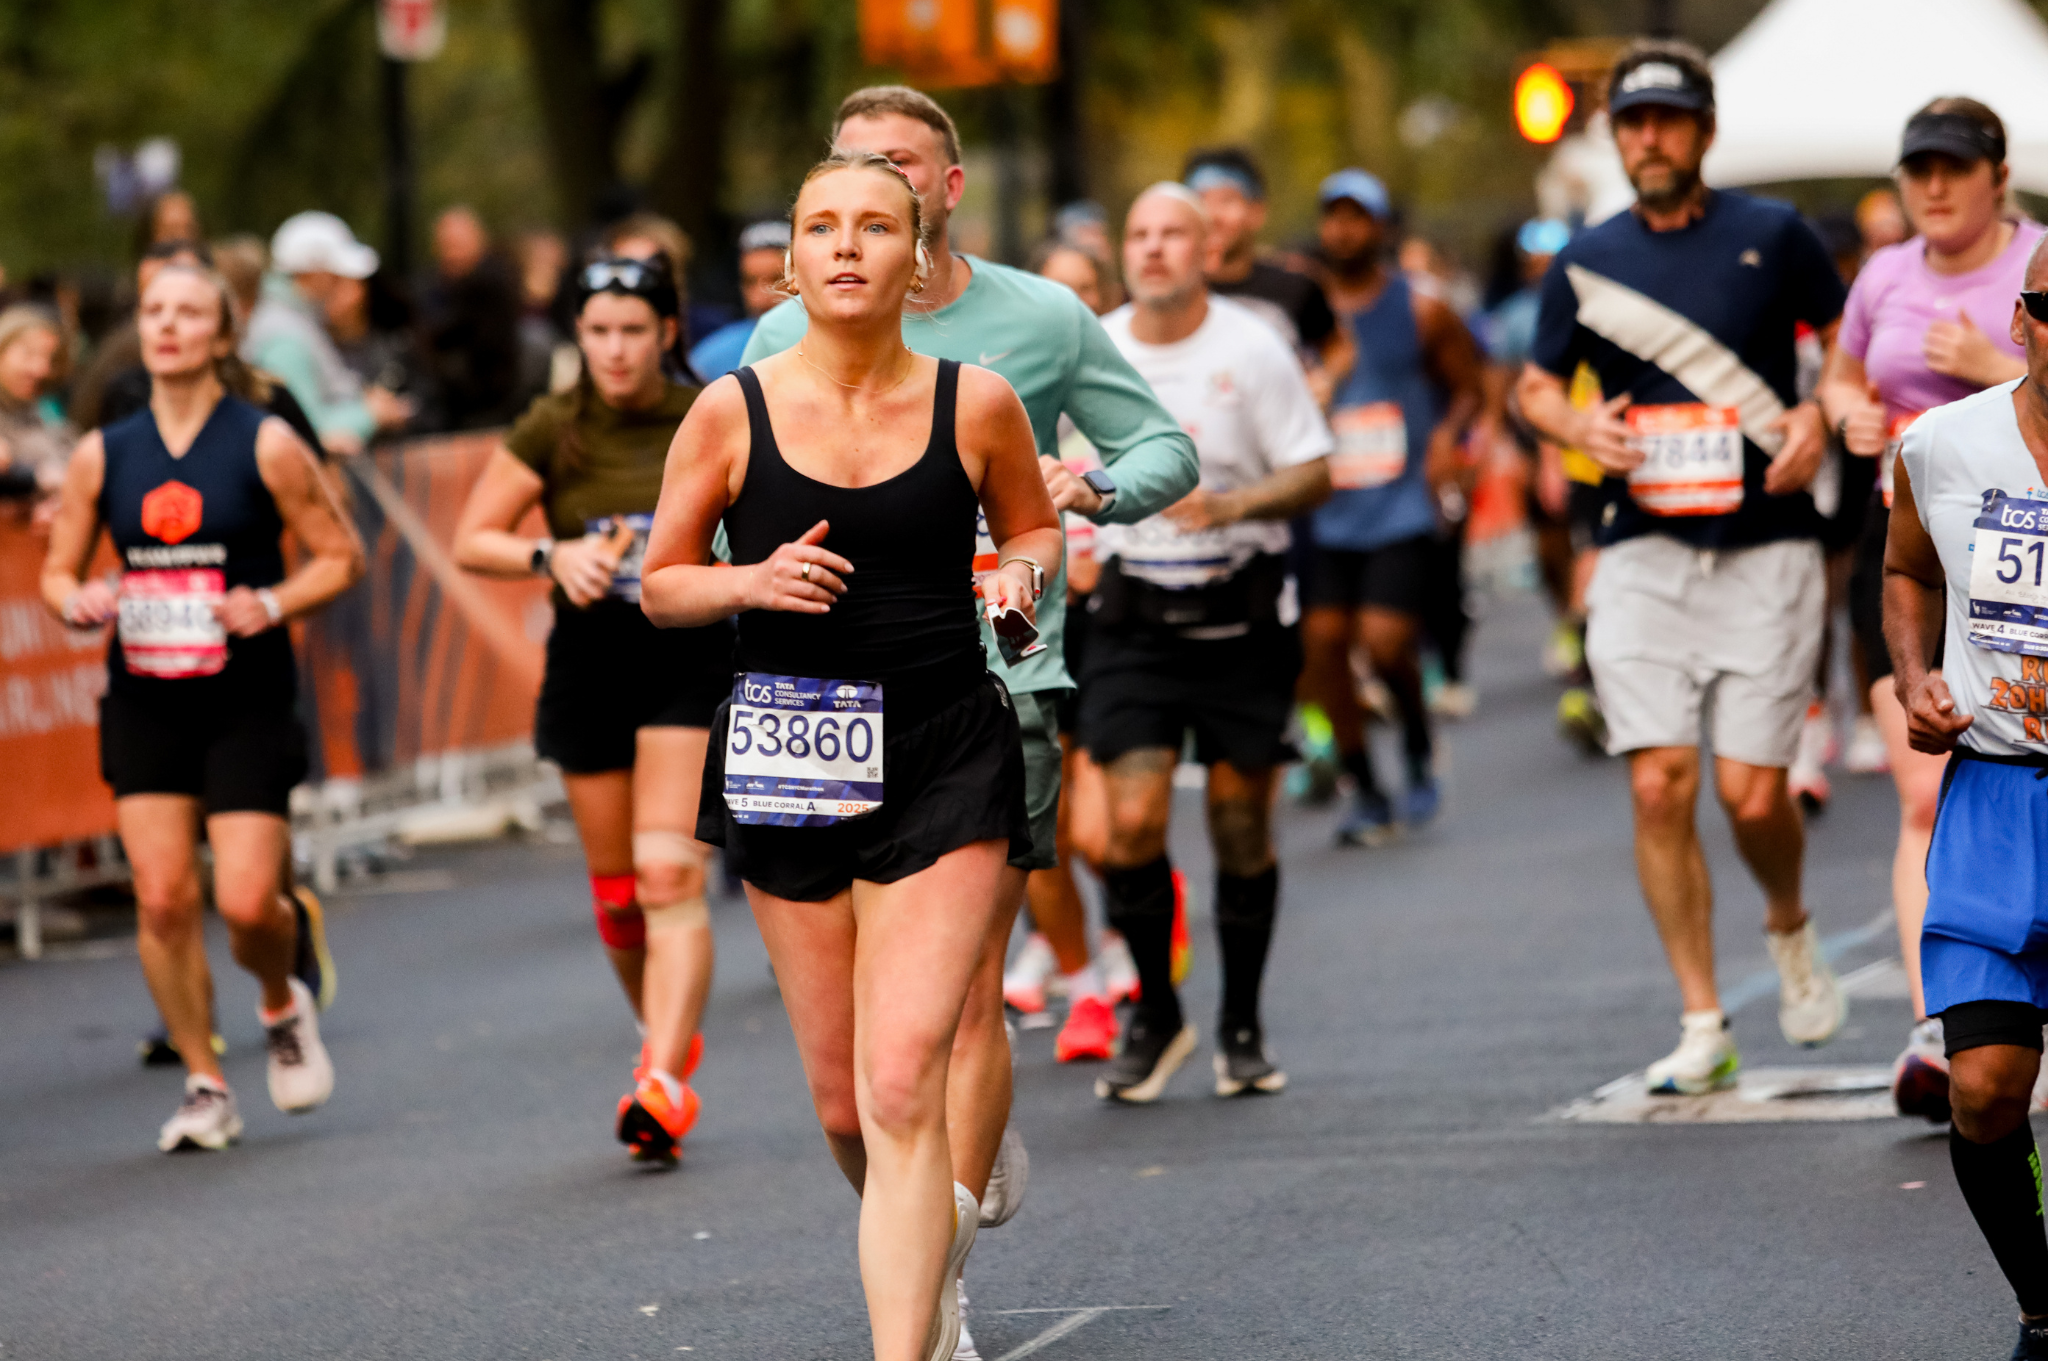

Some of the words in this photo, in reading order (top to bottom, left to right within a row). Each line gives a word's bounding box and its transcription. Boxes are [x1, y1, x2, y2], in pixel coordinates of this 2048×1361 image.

[2001, 504, 2037, 530] tcs
[1996, 537, 2045, 587] 51
[1972, 623, 1995, 631] WAVE
[1997, 625, 2005, 634] 4
[2010, 628, 2028, 636] BLUE
[744, 679, 772, 704] tcs
[775, 682, 795, 691] TATA
[775, 690, 821, 700] CONSULTANCY
[774, 698, 805, 707] SERVICES
[833, 700, 861, 709] TATA
[731, 710, 873, 763] 53860
[741, 798, 748, 807] 5
[753, 800, 773, 808] BLUE
[774, 801, 805, 810] CORRAL
[806, 802, 816, 812] A
[837, 803, 869, 814] 2025
